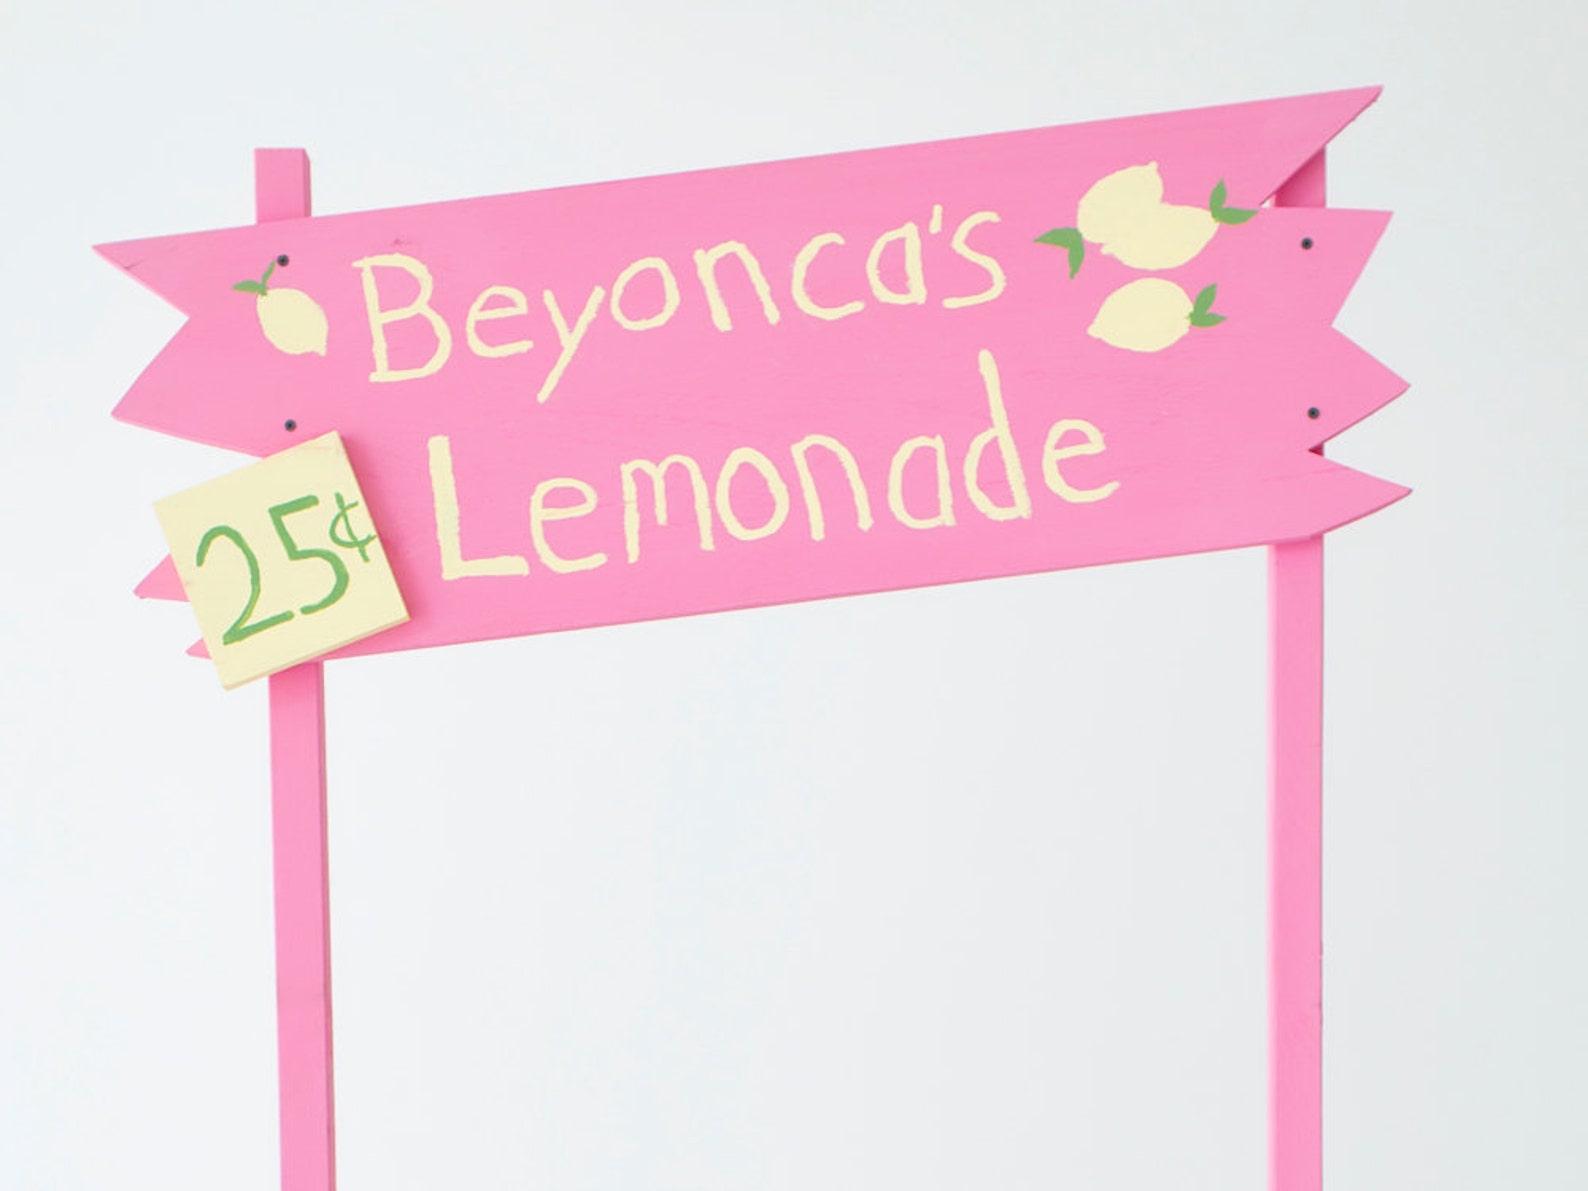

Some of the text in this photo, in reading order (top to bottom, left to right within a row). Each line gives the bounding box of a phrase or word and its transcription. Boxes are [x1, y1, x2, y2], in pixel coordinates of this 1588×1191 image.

[351, 203, 1007, 402] Beyonca's
[426, 349, 1121, 581] Lemonade
[195, 491, 376, 646] 25¢
